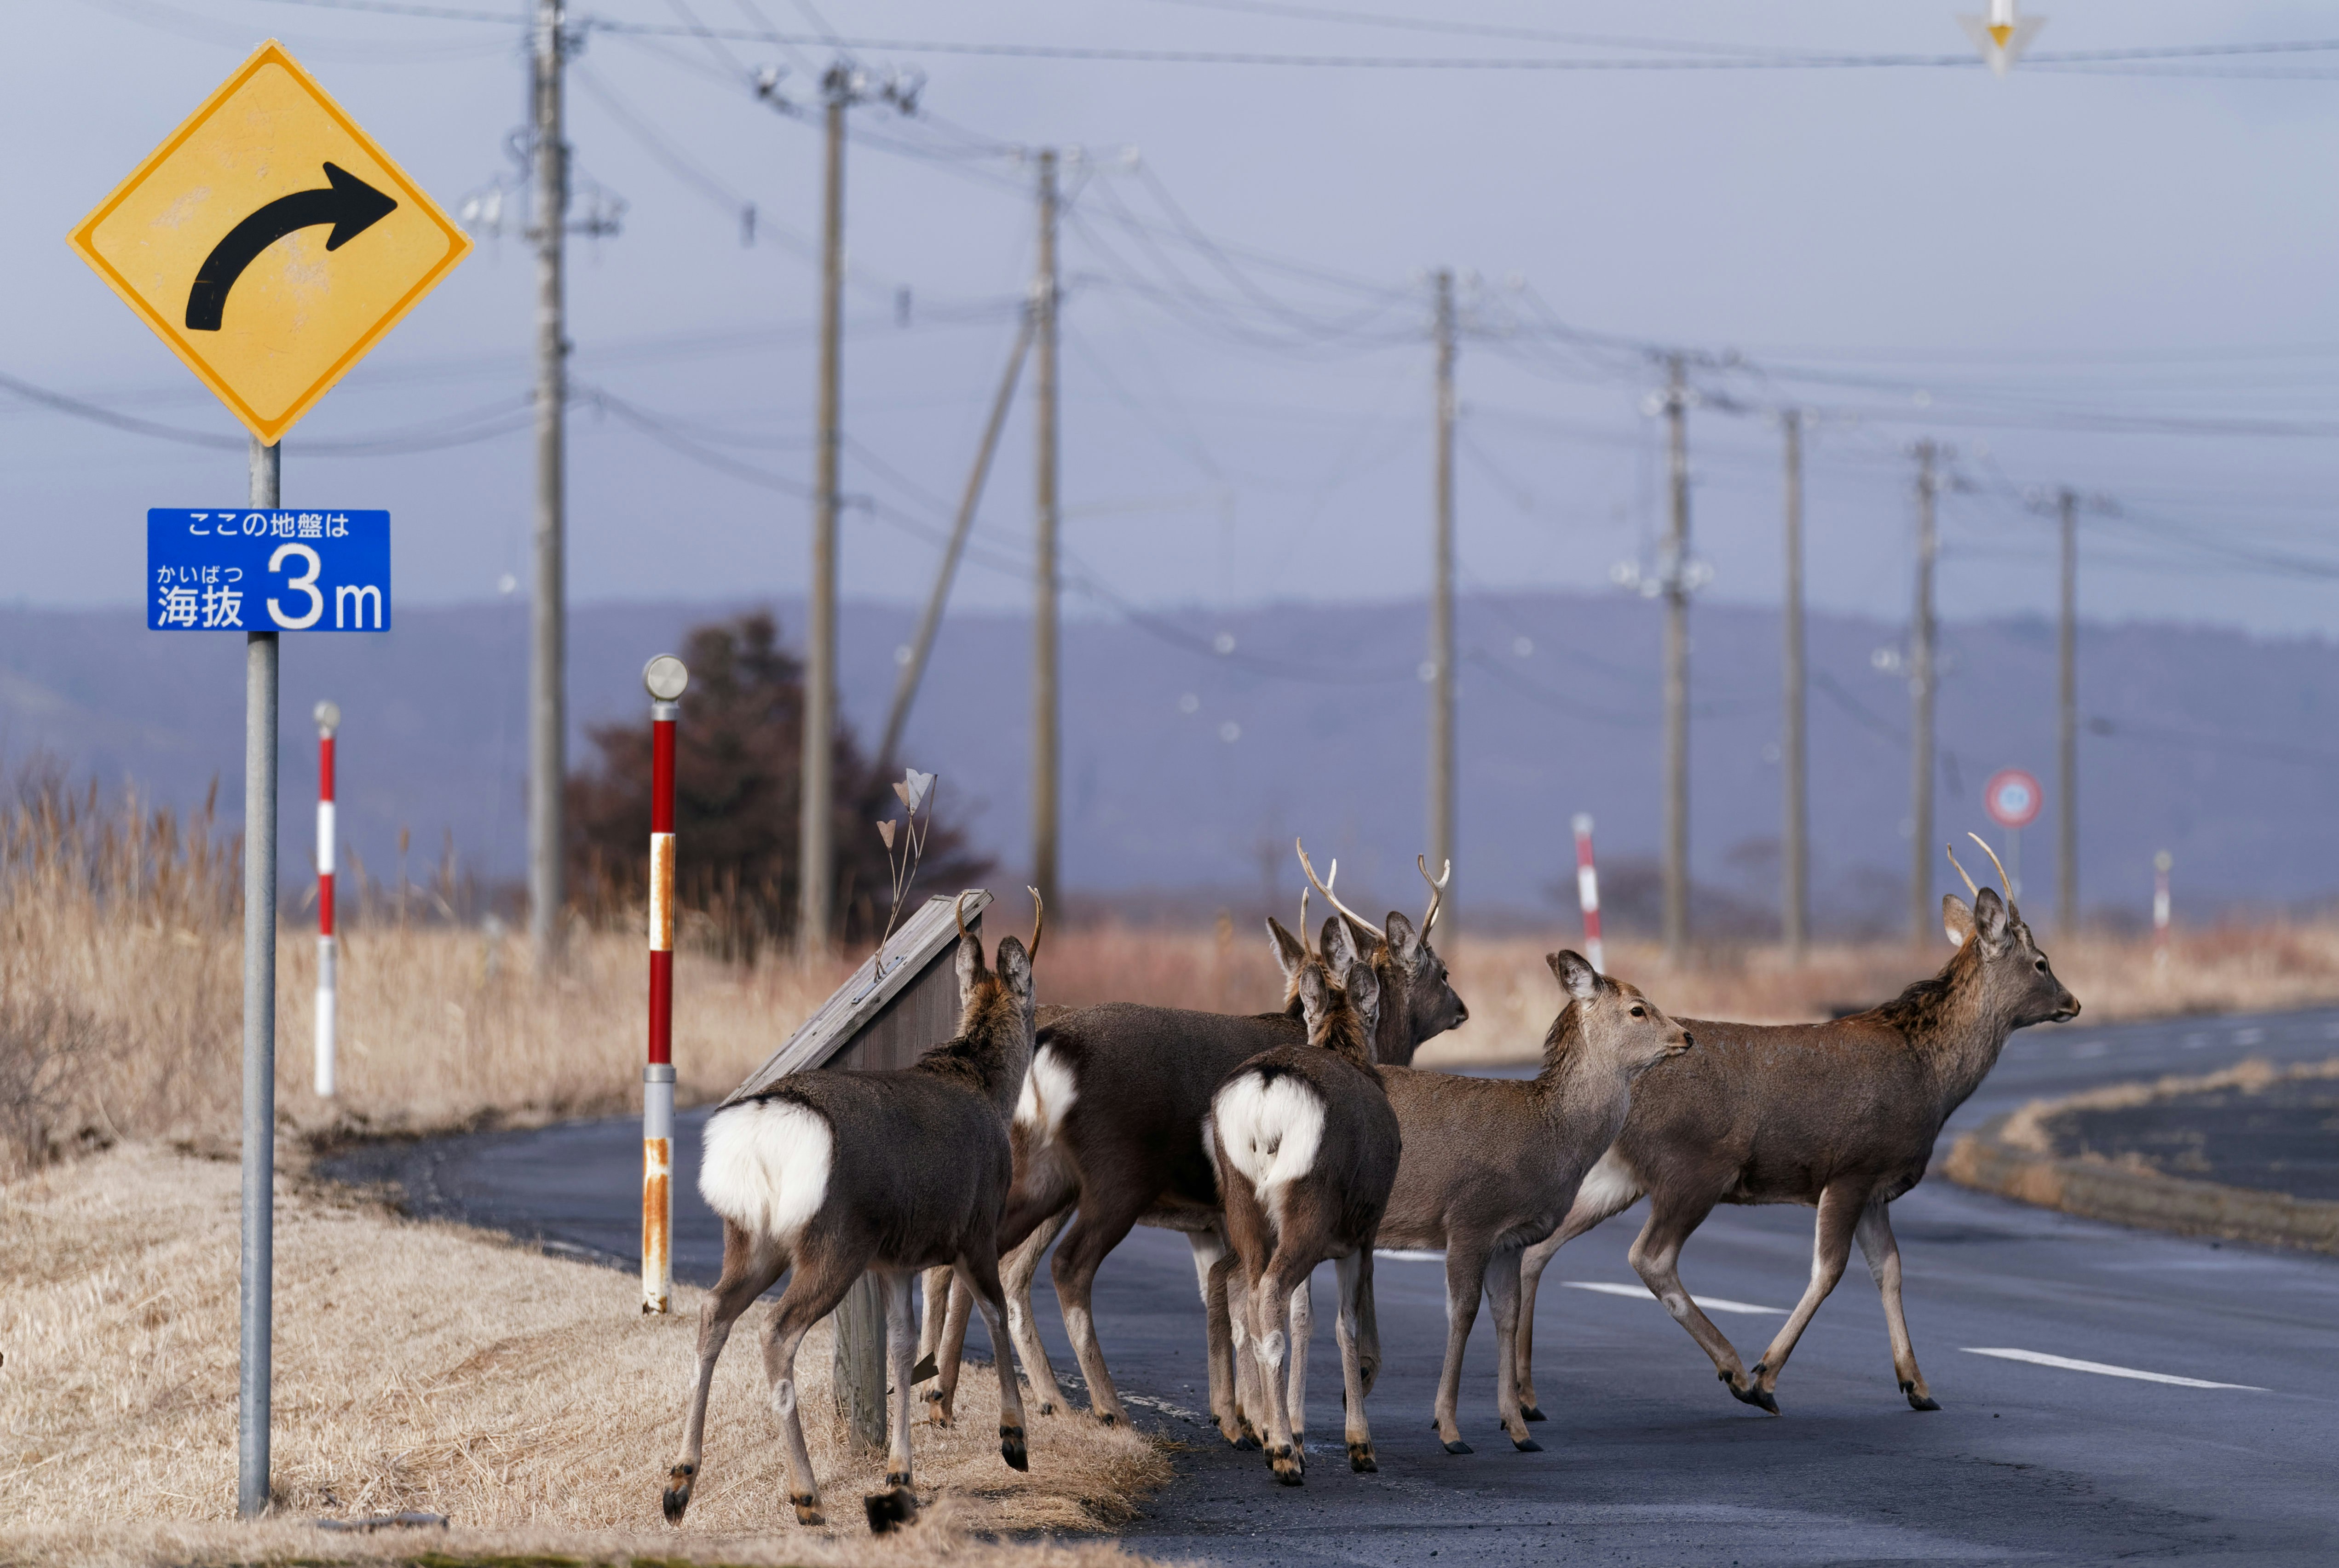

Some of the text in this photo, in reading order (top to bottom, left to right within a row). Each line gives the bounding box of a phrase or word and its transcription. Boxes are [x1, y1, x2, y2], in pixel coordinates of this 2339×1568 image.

[190, 512, 349, 538] ここの地盤は
[157, 565, 242, 584] かいばつ
[157, 585, 243, 627] 海抜
